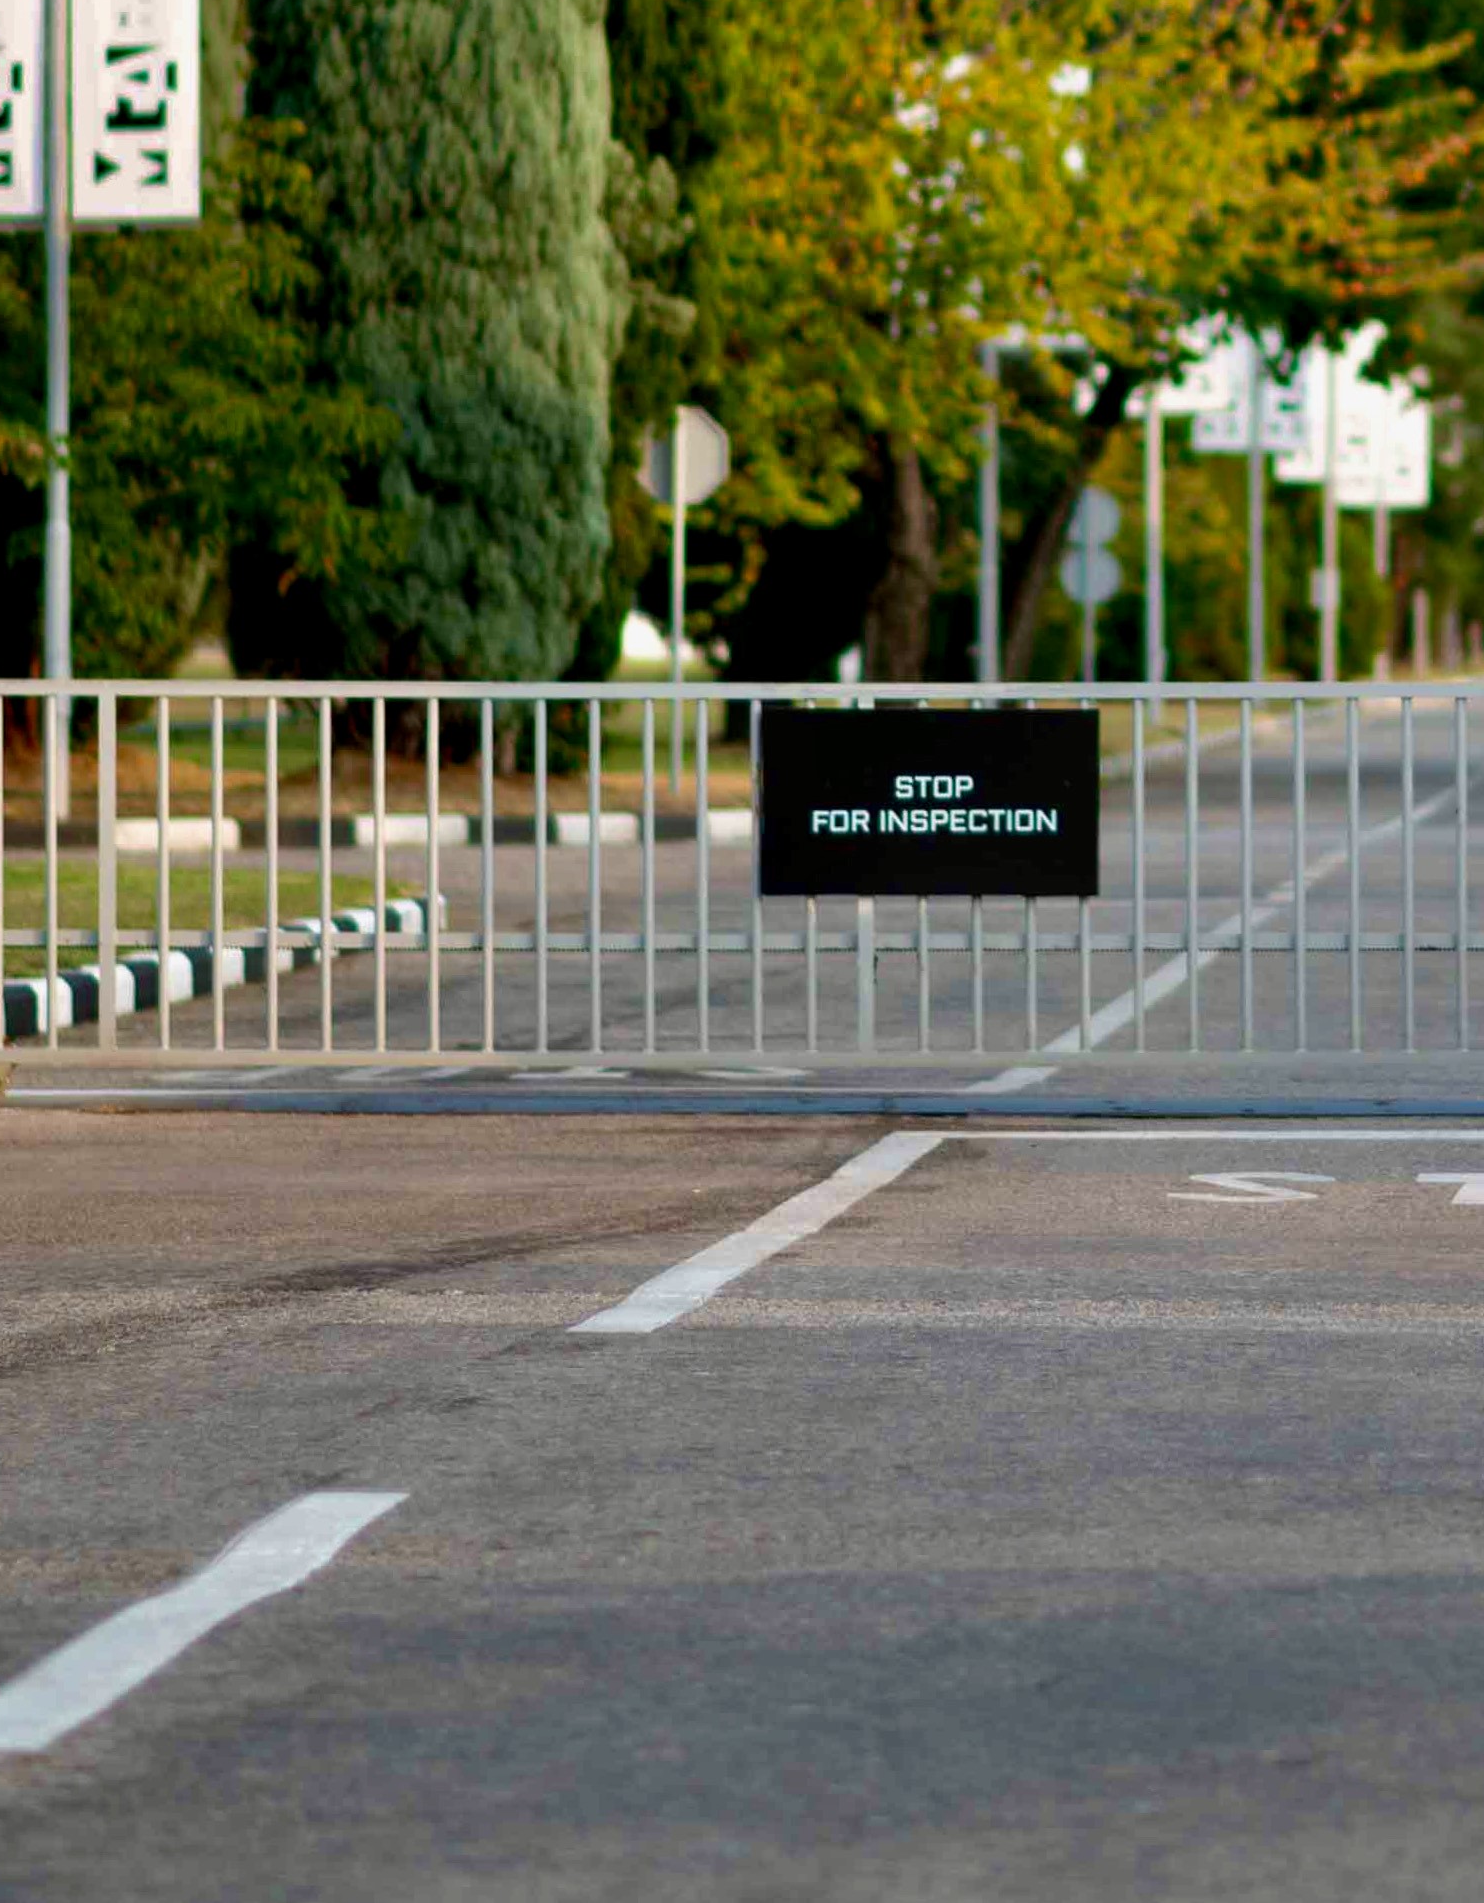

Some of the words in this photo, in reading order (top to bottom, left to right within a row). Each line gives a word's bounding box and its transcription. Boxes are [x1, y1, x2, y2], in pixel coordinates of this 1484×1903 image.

[895, 775, 975, 799] STOP
[812, 809, 870, 833] FOR
[879, 809, 1058, 833] INSPECTION
